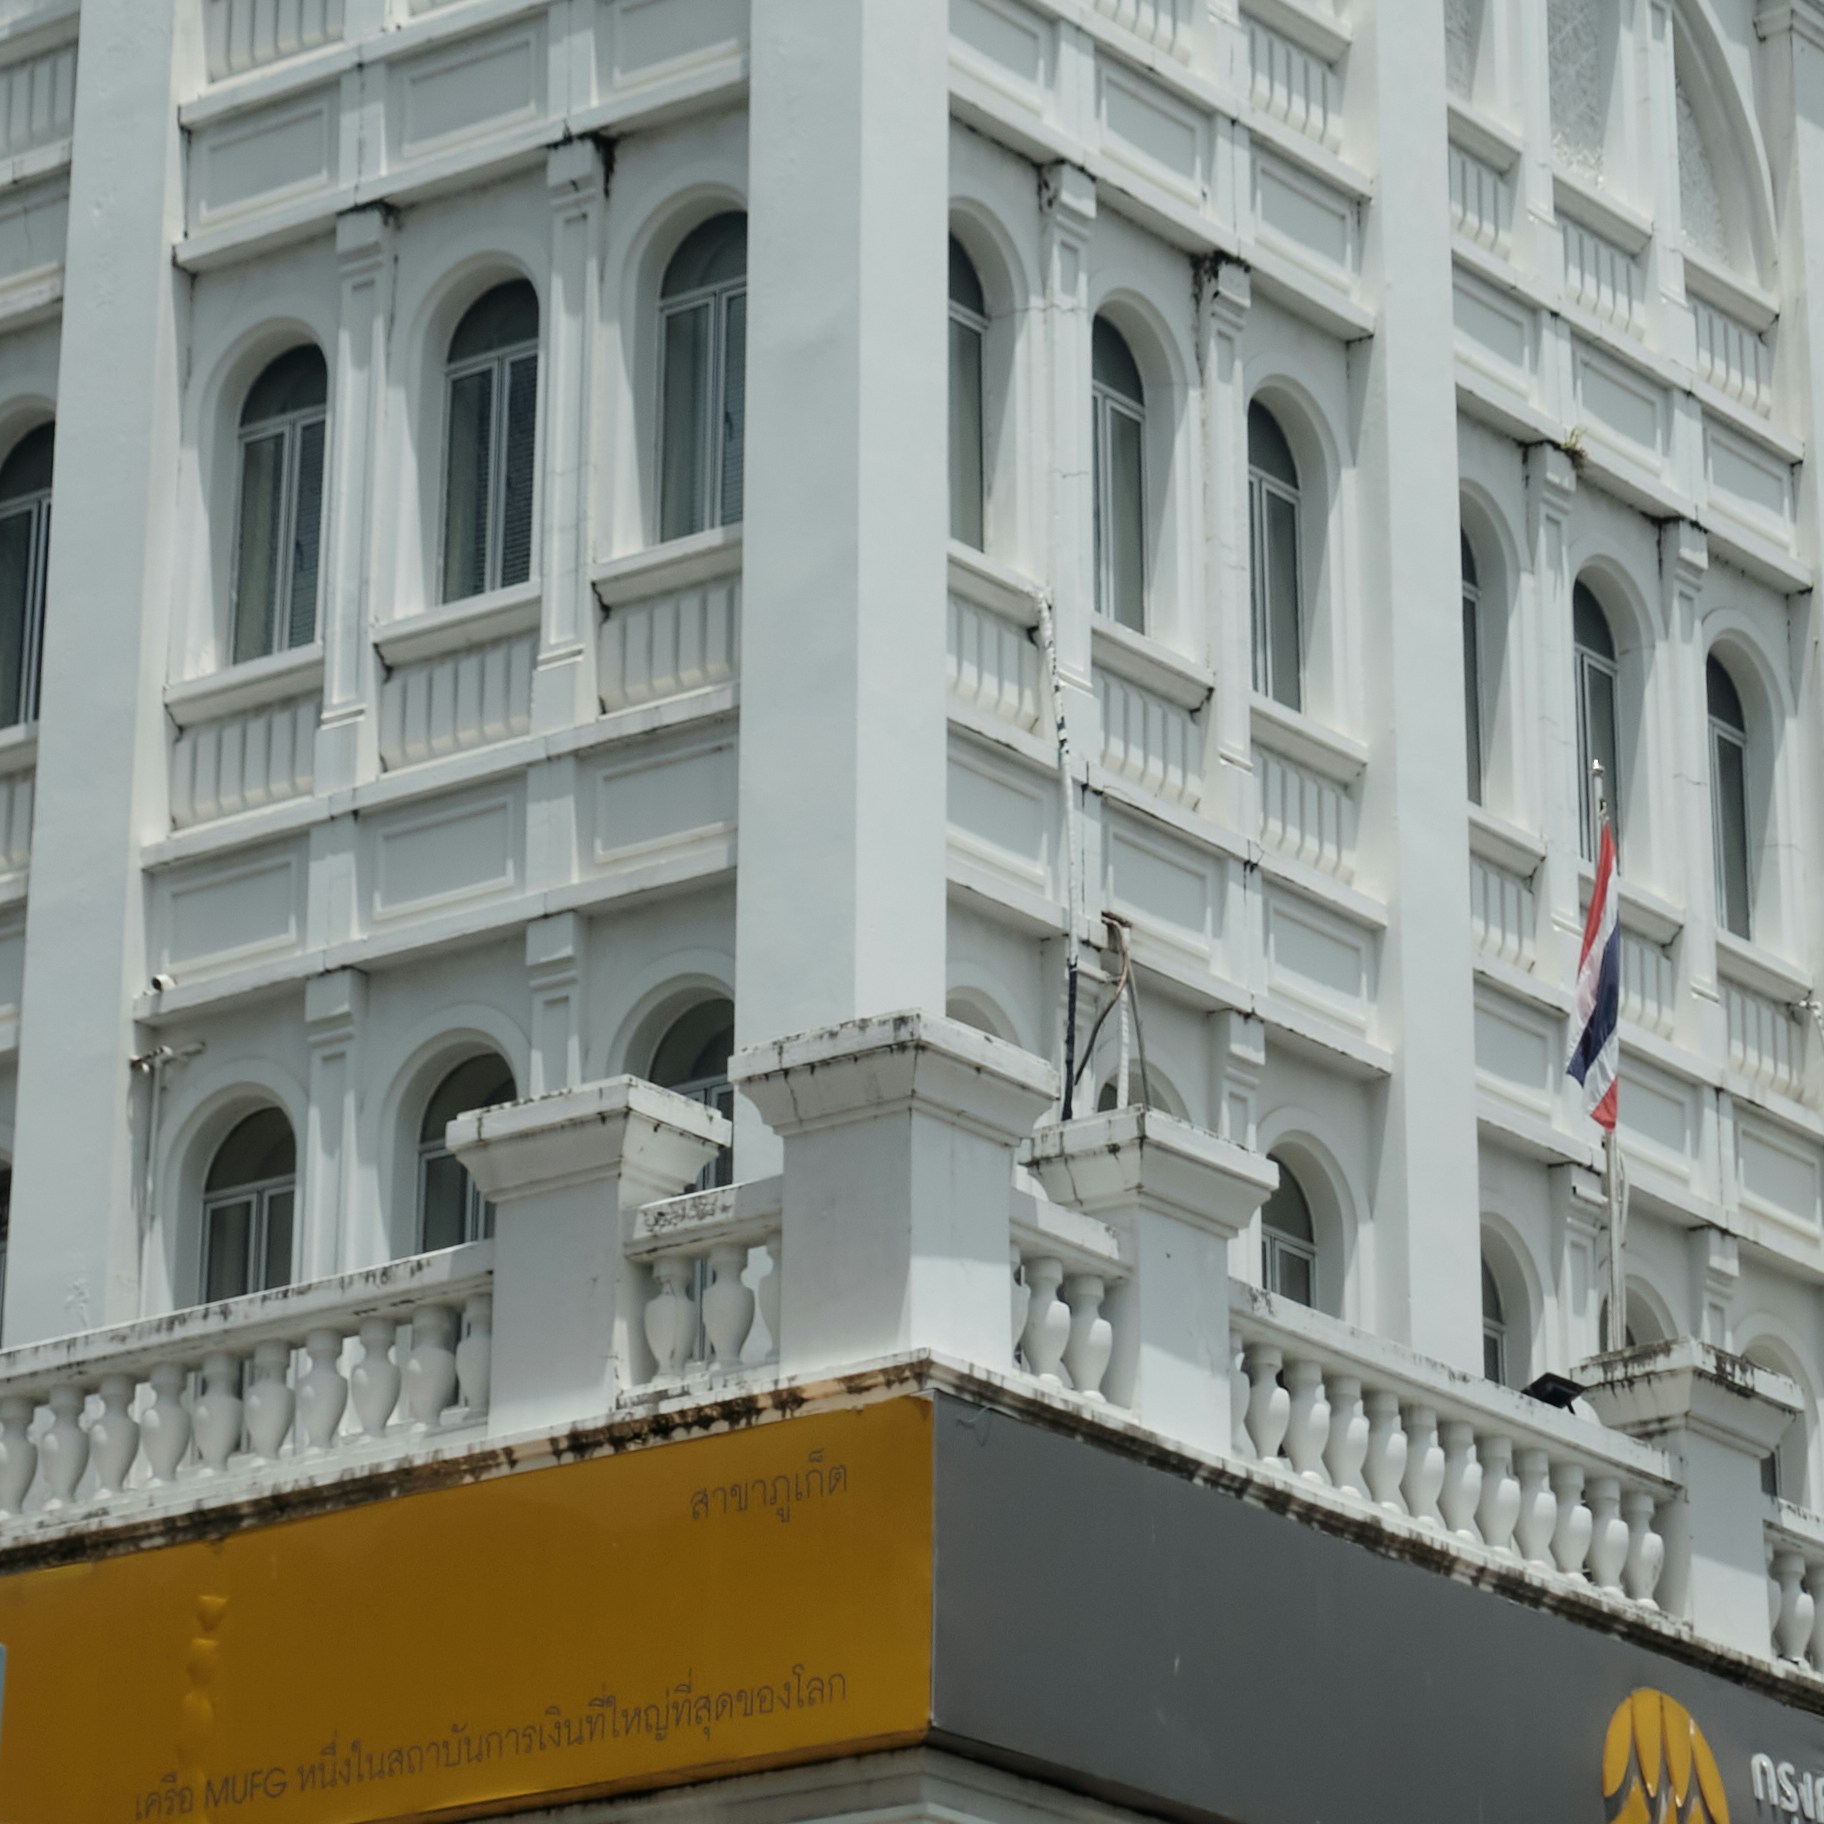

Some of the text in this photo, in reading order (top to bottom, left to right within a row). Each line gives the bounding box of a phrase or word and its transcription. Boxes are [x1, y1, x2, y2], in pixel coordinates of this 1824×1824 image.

[690, 1446, 849, 1524] สาขาภูเก็ต
[134, 1770, 195, 1822] เครือ
[204, 1766, 289, 1811] MUFG
